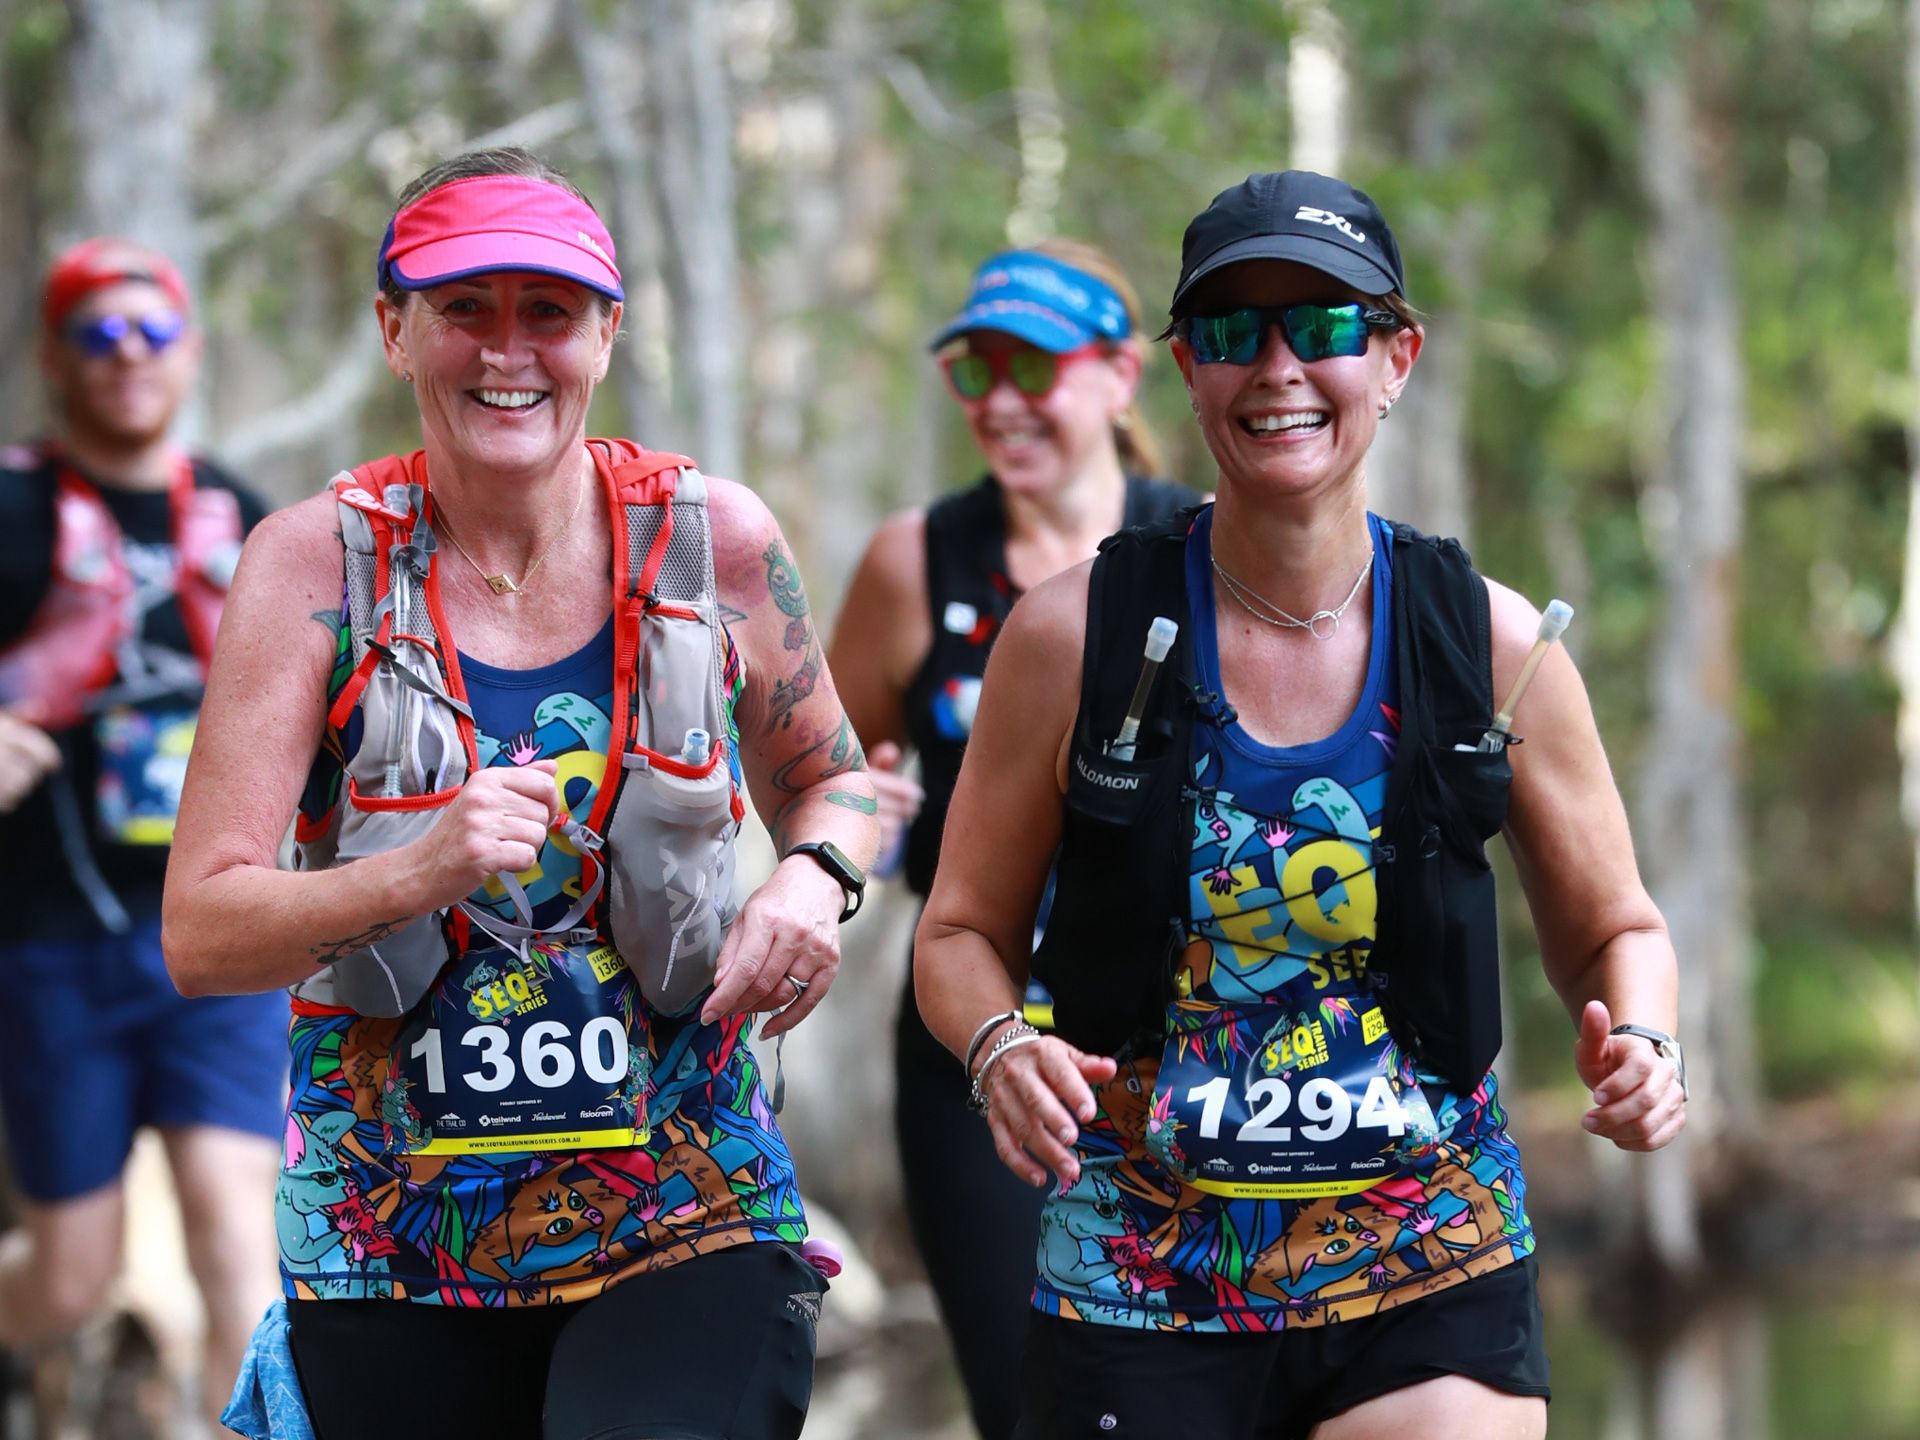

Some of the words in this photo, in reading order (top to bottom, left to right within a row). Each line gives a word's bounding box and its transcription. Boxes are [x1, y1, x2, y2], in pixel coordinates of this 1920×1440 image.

[1295, 206, 1365, 243] 2XU
[597, 954, 625, 977] 1360
[471, 972, 533, 1018] SEQ
[514, 994, 548, 1017] SERIES
[1310, 1019, 1327, 1053] TRAIL
[411, 1016, 629, 1093] 1360
[1266, 1026, 1316, 1071] SEQ
[1296, 1050, 1329, 1071] SERIES
[491, 1115, 521, 1124] tailwind
[580, 1109, 613, 1119] fisiocrem
[1187, 1077, 1411, 1142] 1294
[445, 1119, 458, 1127] TRAIL
[468, 1137, 581, 1148] WWW.SEQTRAILRUNNINGSERIES.COM.AU
[1260, 1165, 1291, 1173] tailwind
[1351, 1161, 1385, 1170] fisiocrem
